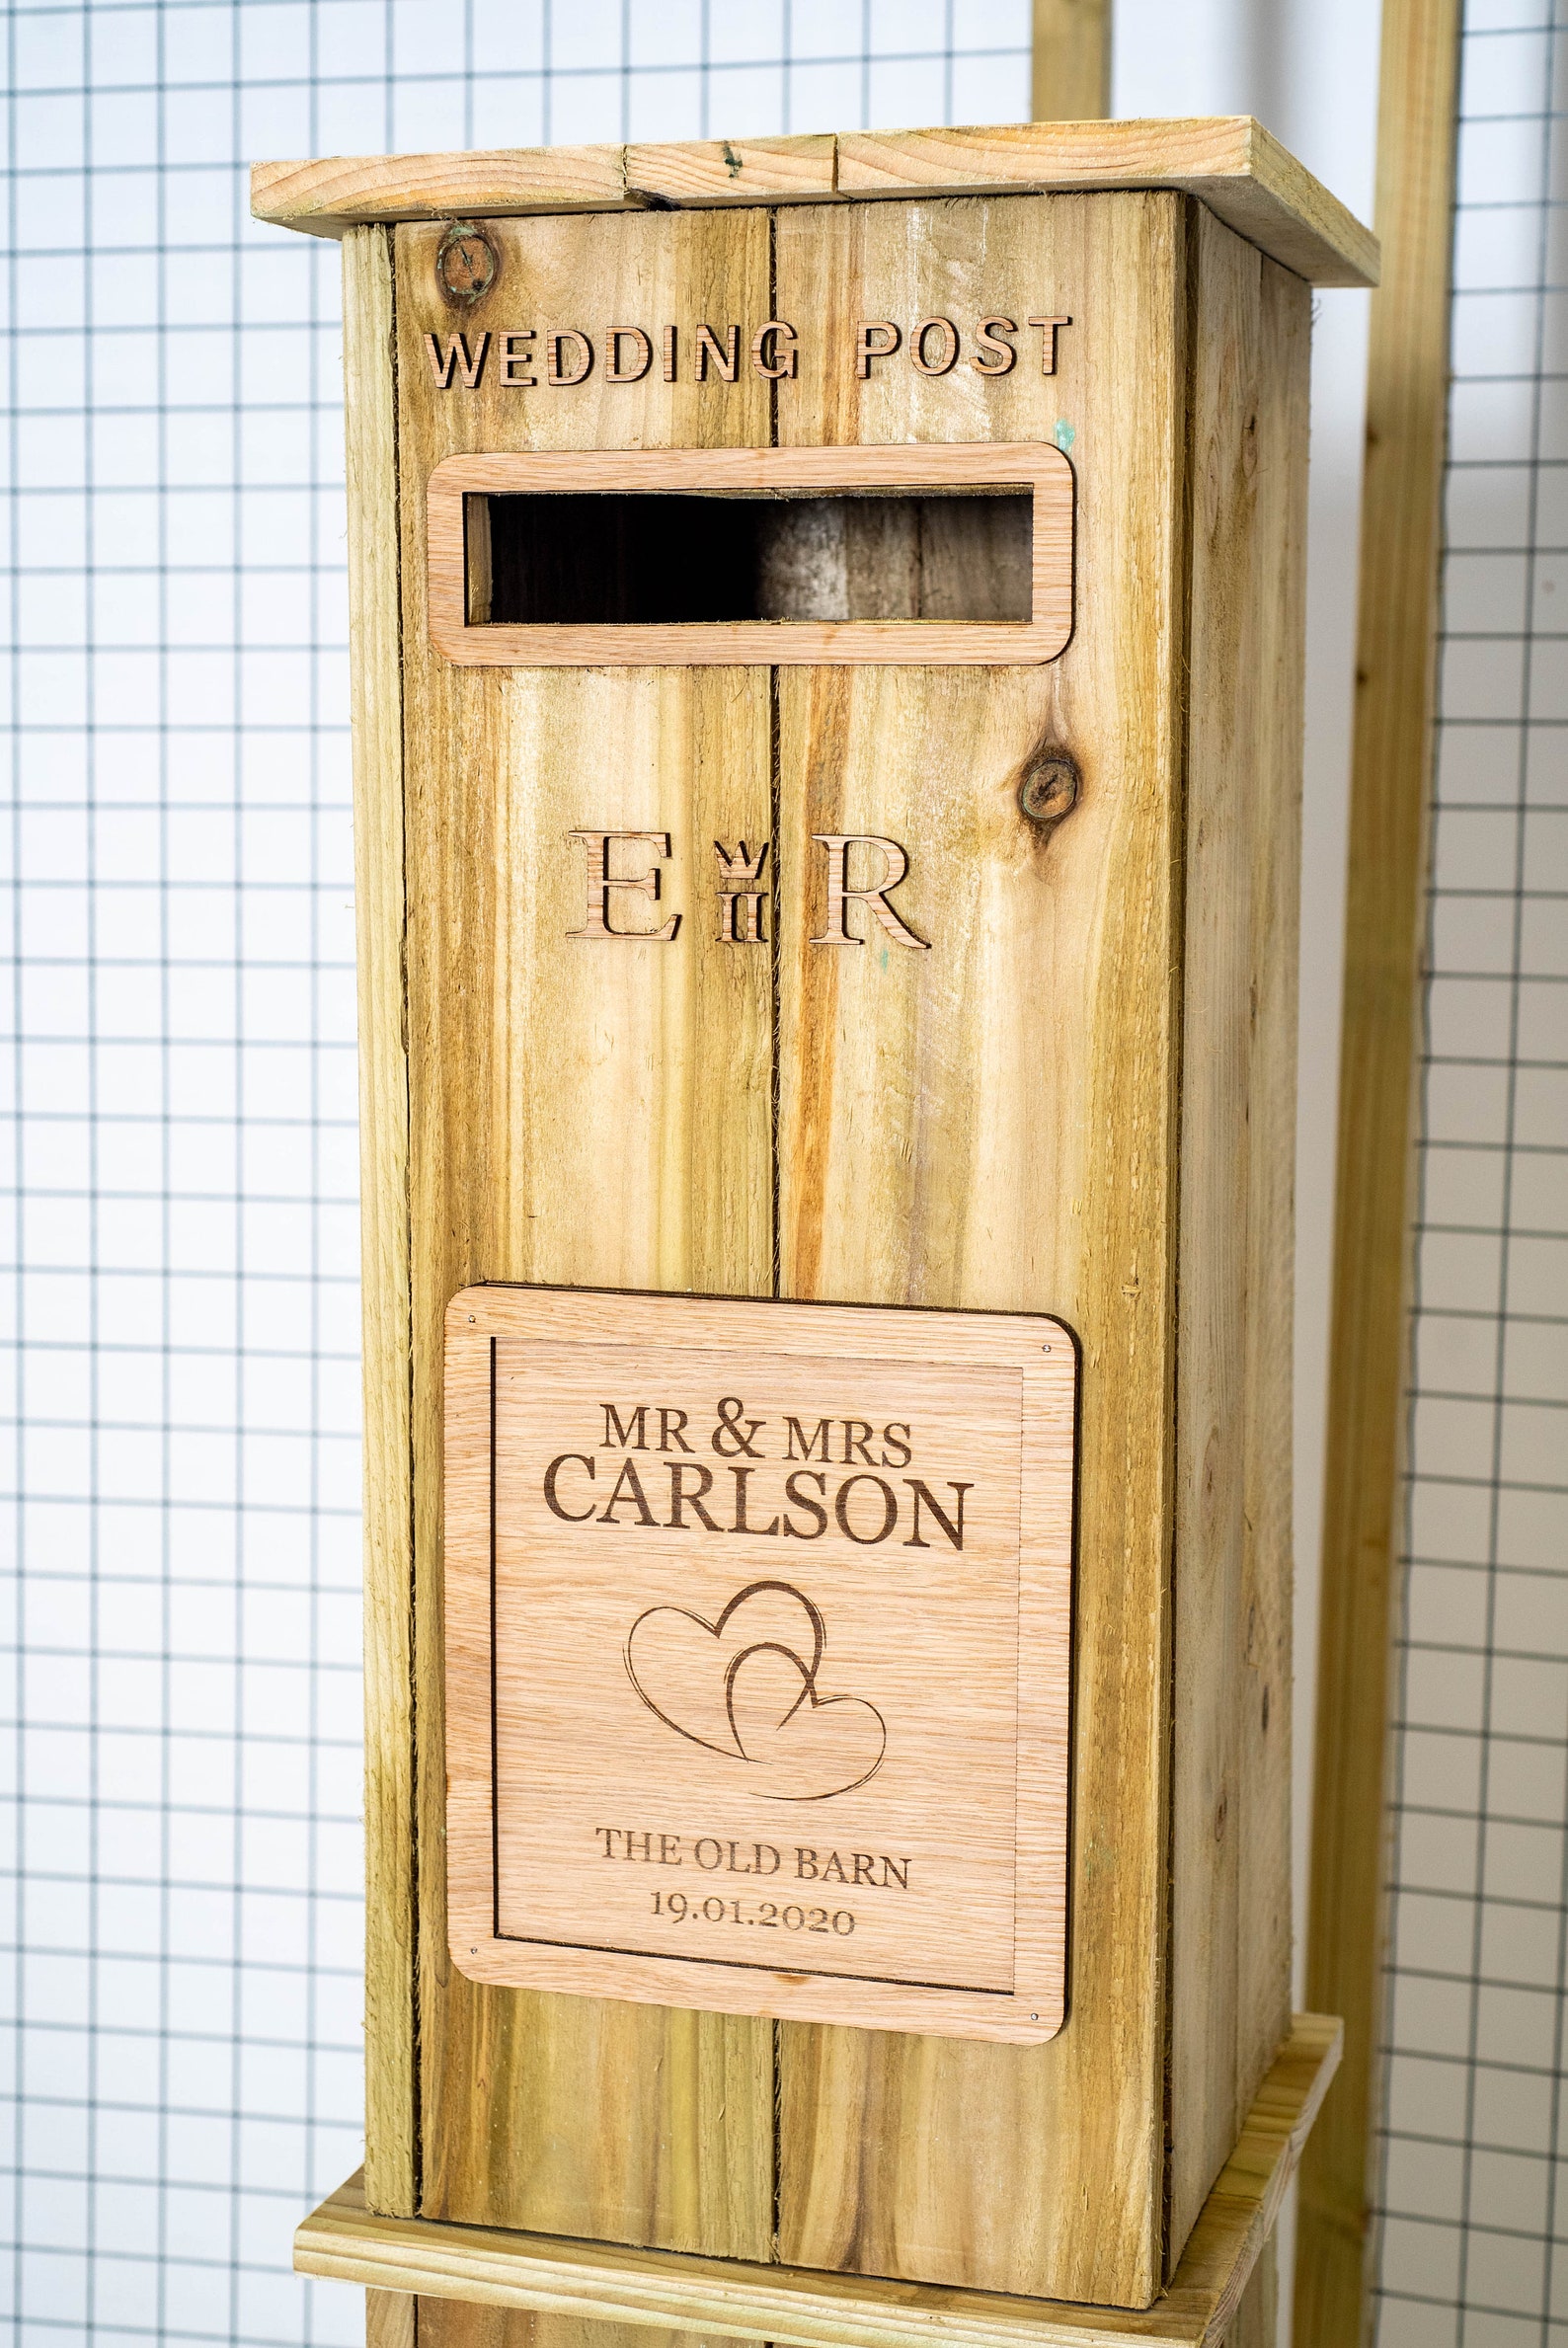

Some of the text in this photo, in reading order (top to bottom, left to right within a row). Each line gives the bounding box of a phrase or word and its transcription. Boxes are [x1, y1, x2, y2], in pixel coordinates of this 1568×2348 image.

[422, 314, 1073, 389] WEDDING POST
[565, 829, 683, 942] E
[808, 832, 933, 951] R
[598, 1395, 913, 1469] MR & MRS
[542, 1452, 976, 1552] CARLSON
[594, 1827, 913, 1890] THE OLD BARN
[649, 1890, 856, 1936] 19.01.2020
